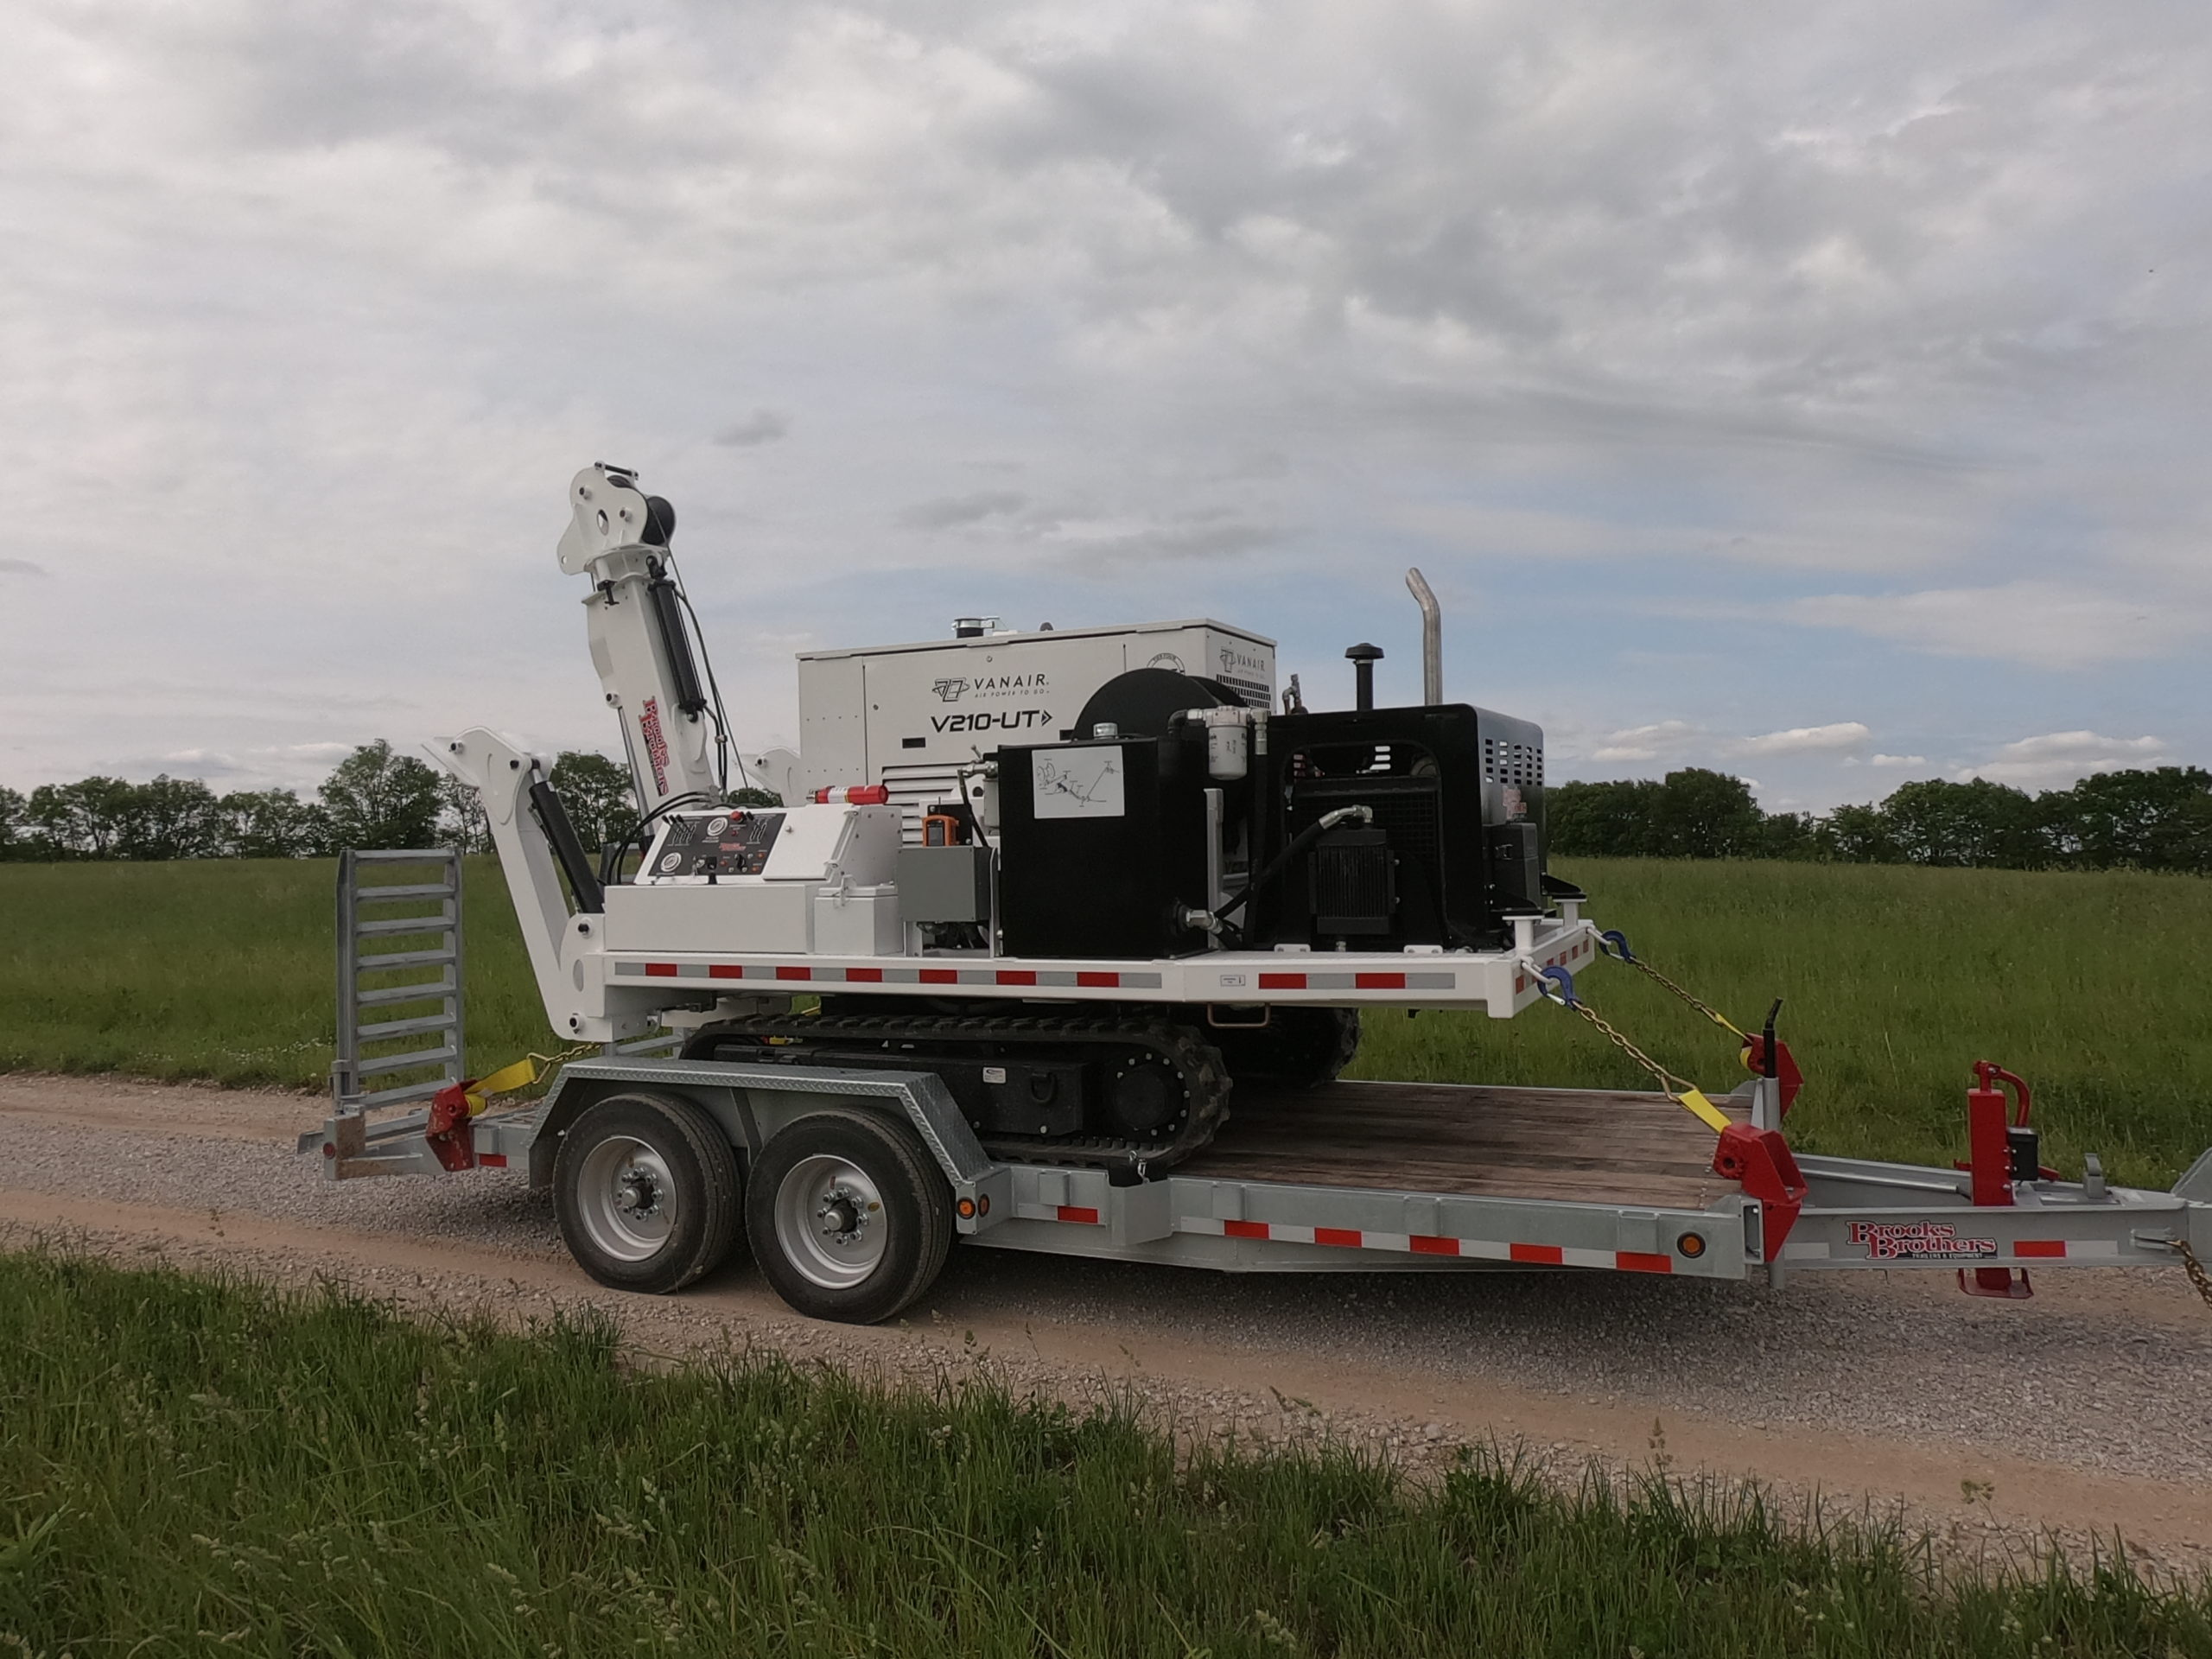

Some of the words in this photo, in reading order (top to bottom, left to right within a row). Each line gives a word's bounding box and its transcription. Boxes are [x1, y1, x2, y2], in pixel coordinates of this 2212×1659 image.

[1236, 653, 1265, 672] VANAIR
[930, 709, 1040, 734] V210-UT
[1847, 1220, 1956, 1245] Brooks
[1866, 1236, 1998, 1261] Brothers
